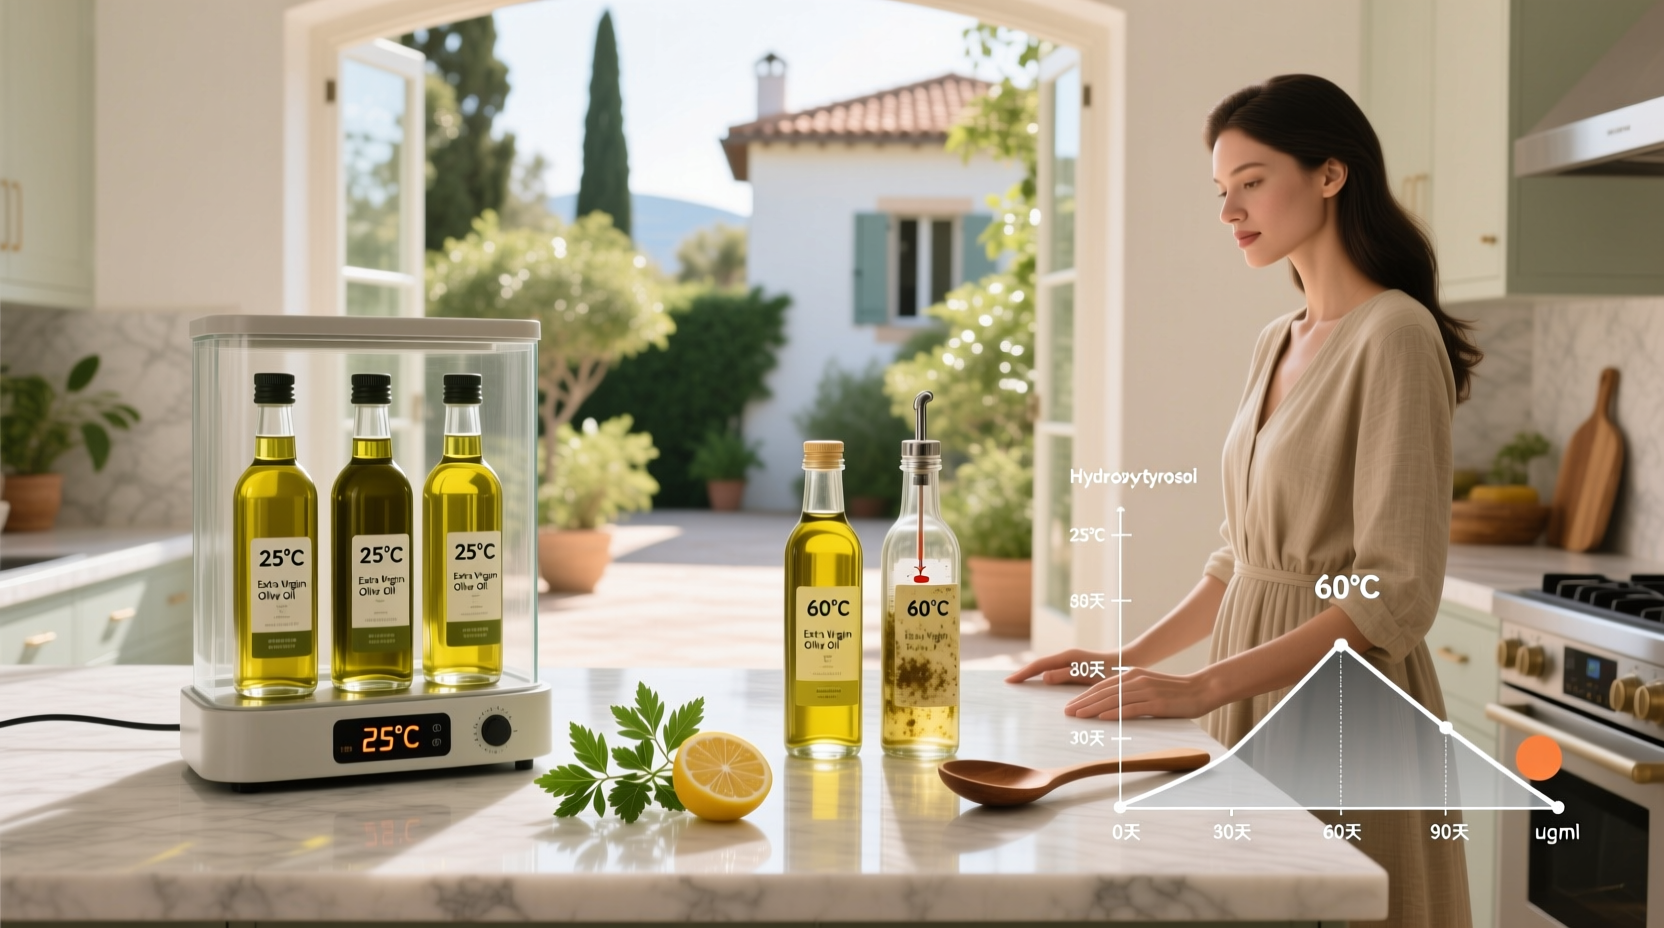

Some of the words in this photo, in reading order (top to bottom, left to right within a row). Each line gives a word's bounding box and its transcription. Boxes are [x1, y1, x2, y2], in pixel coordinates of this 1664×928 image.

[259, 548, 304, 567] 25°C
[359, 545, 403, 564] 25°C
[454, 542, 496, 561] 25°C
[807, 599, 850, 617] 60°C
[907, 599, 949, 617] 60°C
[362, 724, 420, 753] 25°C
